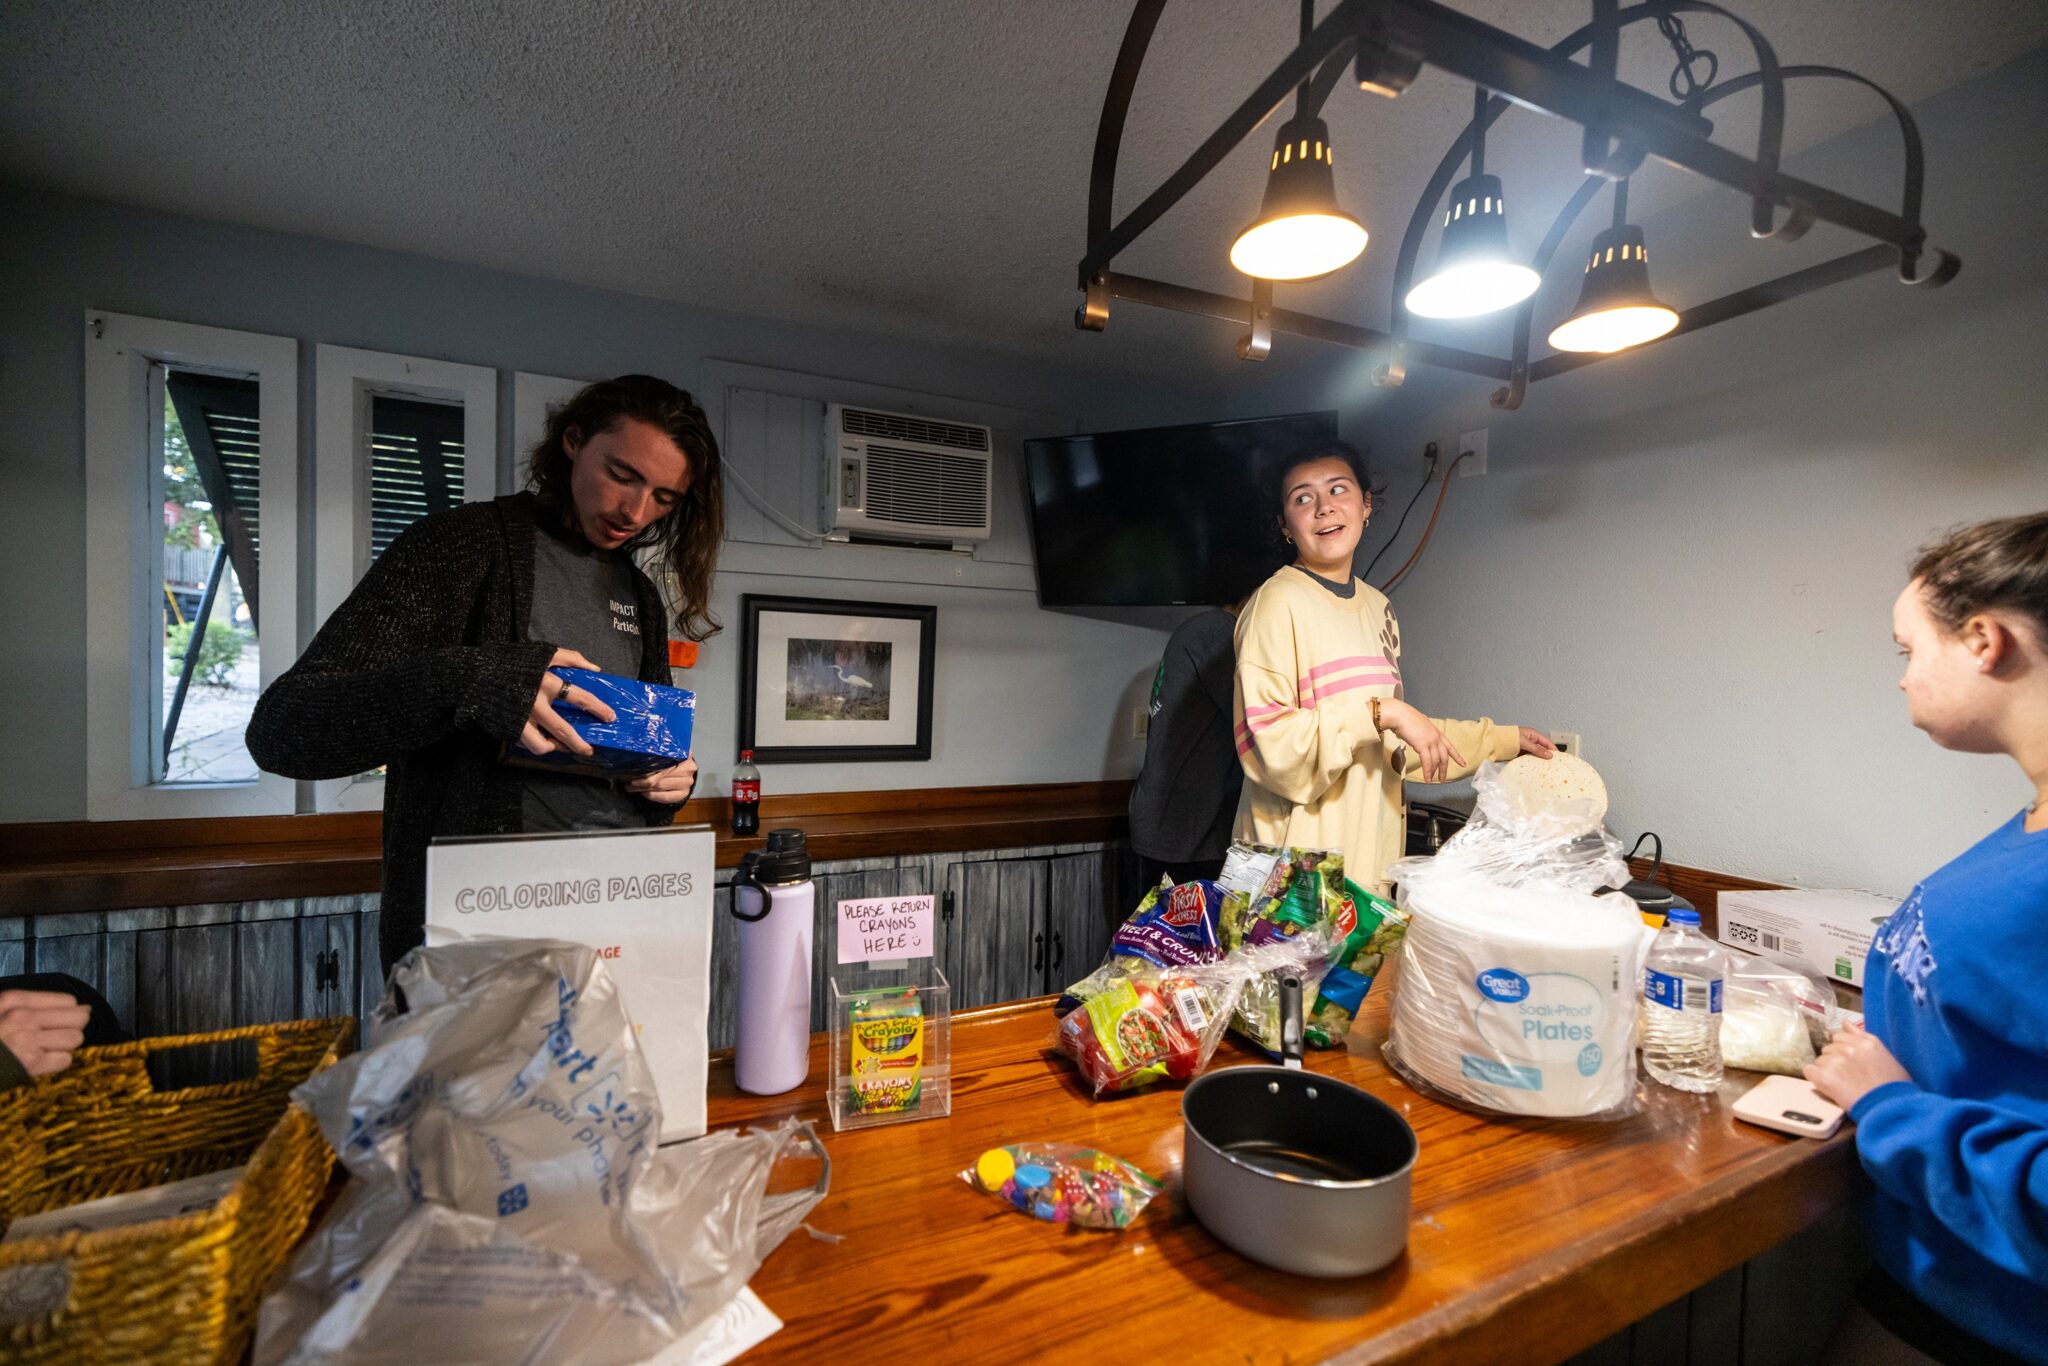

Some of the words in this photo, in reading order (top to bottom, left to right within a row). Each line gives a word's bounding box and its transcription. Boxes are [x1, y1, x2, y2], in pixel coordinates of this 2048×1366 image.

[610, 600, 634, 616] IMPACT
[456, 879, 600, 914] COLORING
[607, 873, 692, 901] PAGES
[1171, 887, 1199, 912] Fresh
[844, 904, 885, 919] PLEASE
[892, 899, 930, 914] RETURN
[860, 917, 916, 934] CRAYONS
[864, 933, 907, 954] HERE
[1119, 922, 1153, 936] WEET
[1149, 931, 1162, 941] &
[1161, 937, 1218, 966] CRUNCH
[1481, 974, 1520, 990] Great
[1490, 985, 1522, 997] Value
[1518, 1003, 1592, 1017] Soak-Proof
[863, 1024, 912, 1038] Crayola
[1522, 1020, 1593, 1041] Plates
[859, 1077, 912, 1093] CRAYONS
